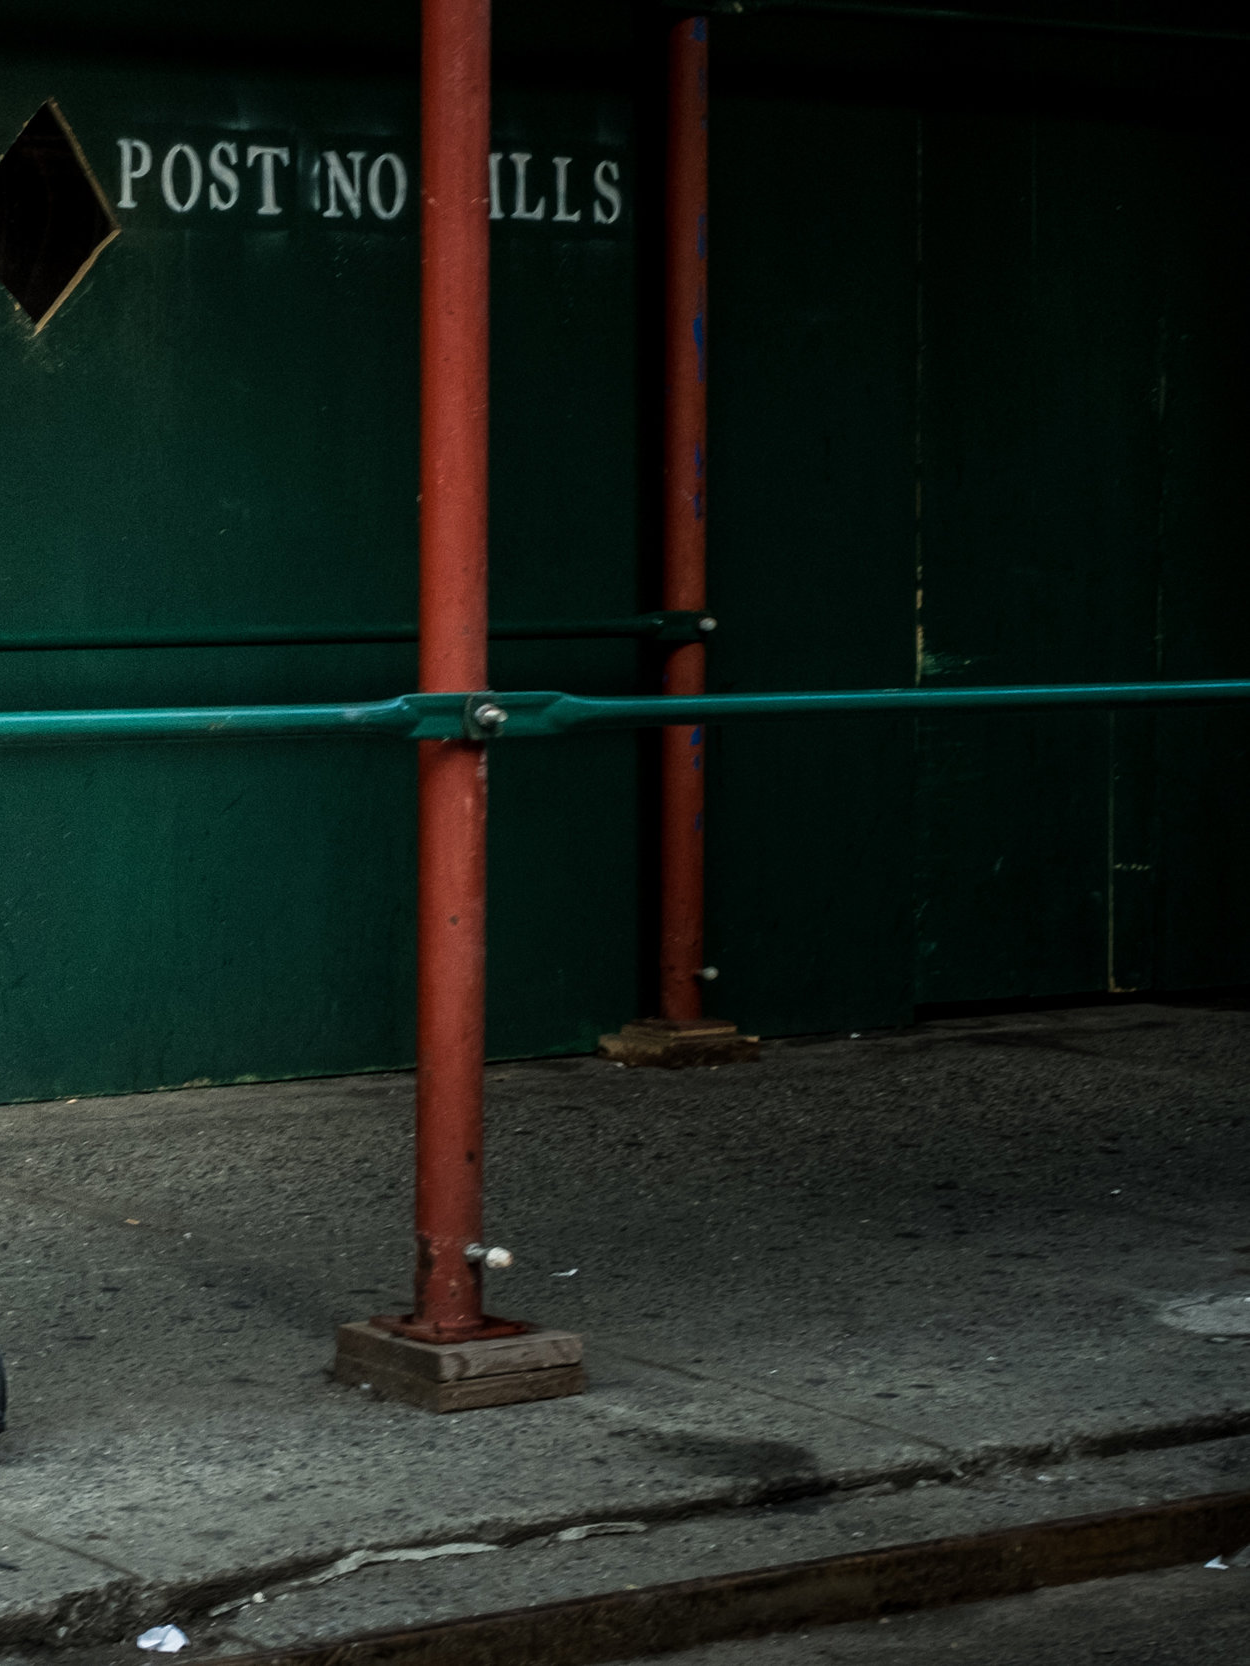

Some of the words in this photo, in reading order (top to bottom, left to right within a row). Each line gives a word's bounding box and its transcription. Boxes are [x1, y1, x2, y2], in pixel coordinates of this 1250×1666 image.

[117, 137, 290, 215] POST
[321, 151, 408, 220] NO
[488, 152, 623, 225] ILLS
